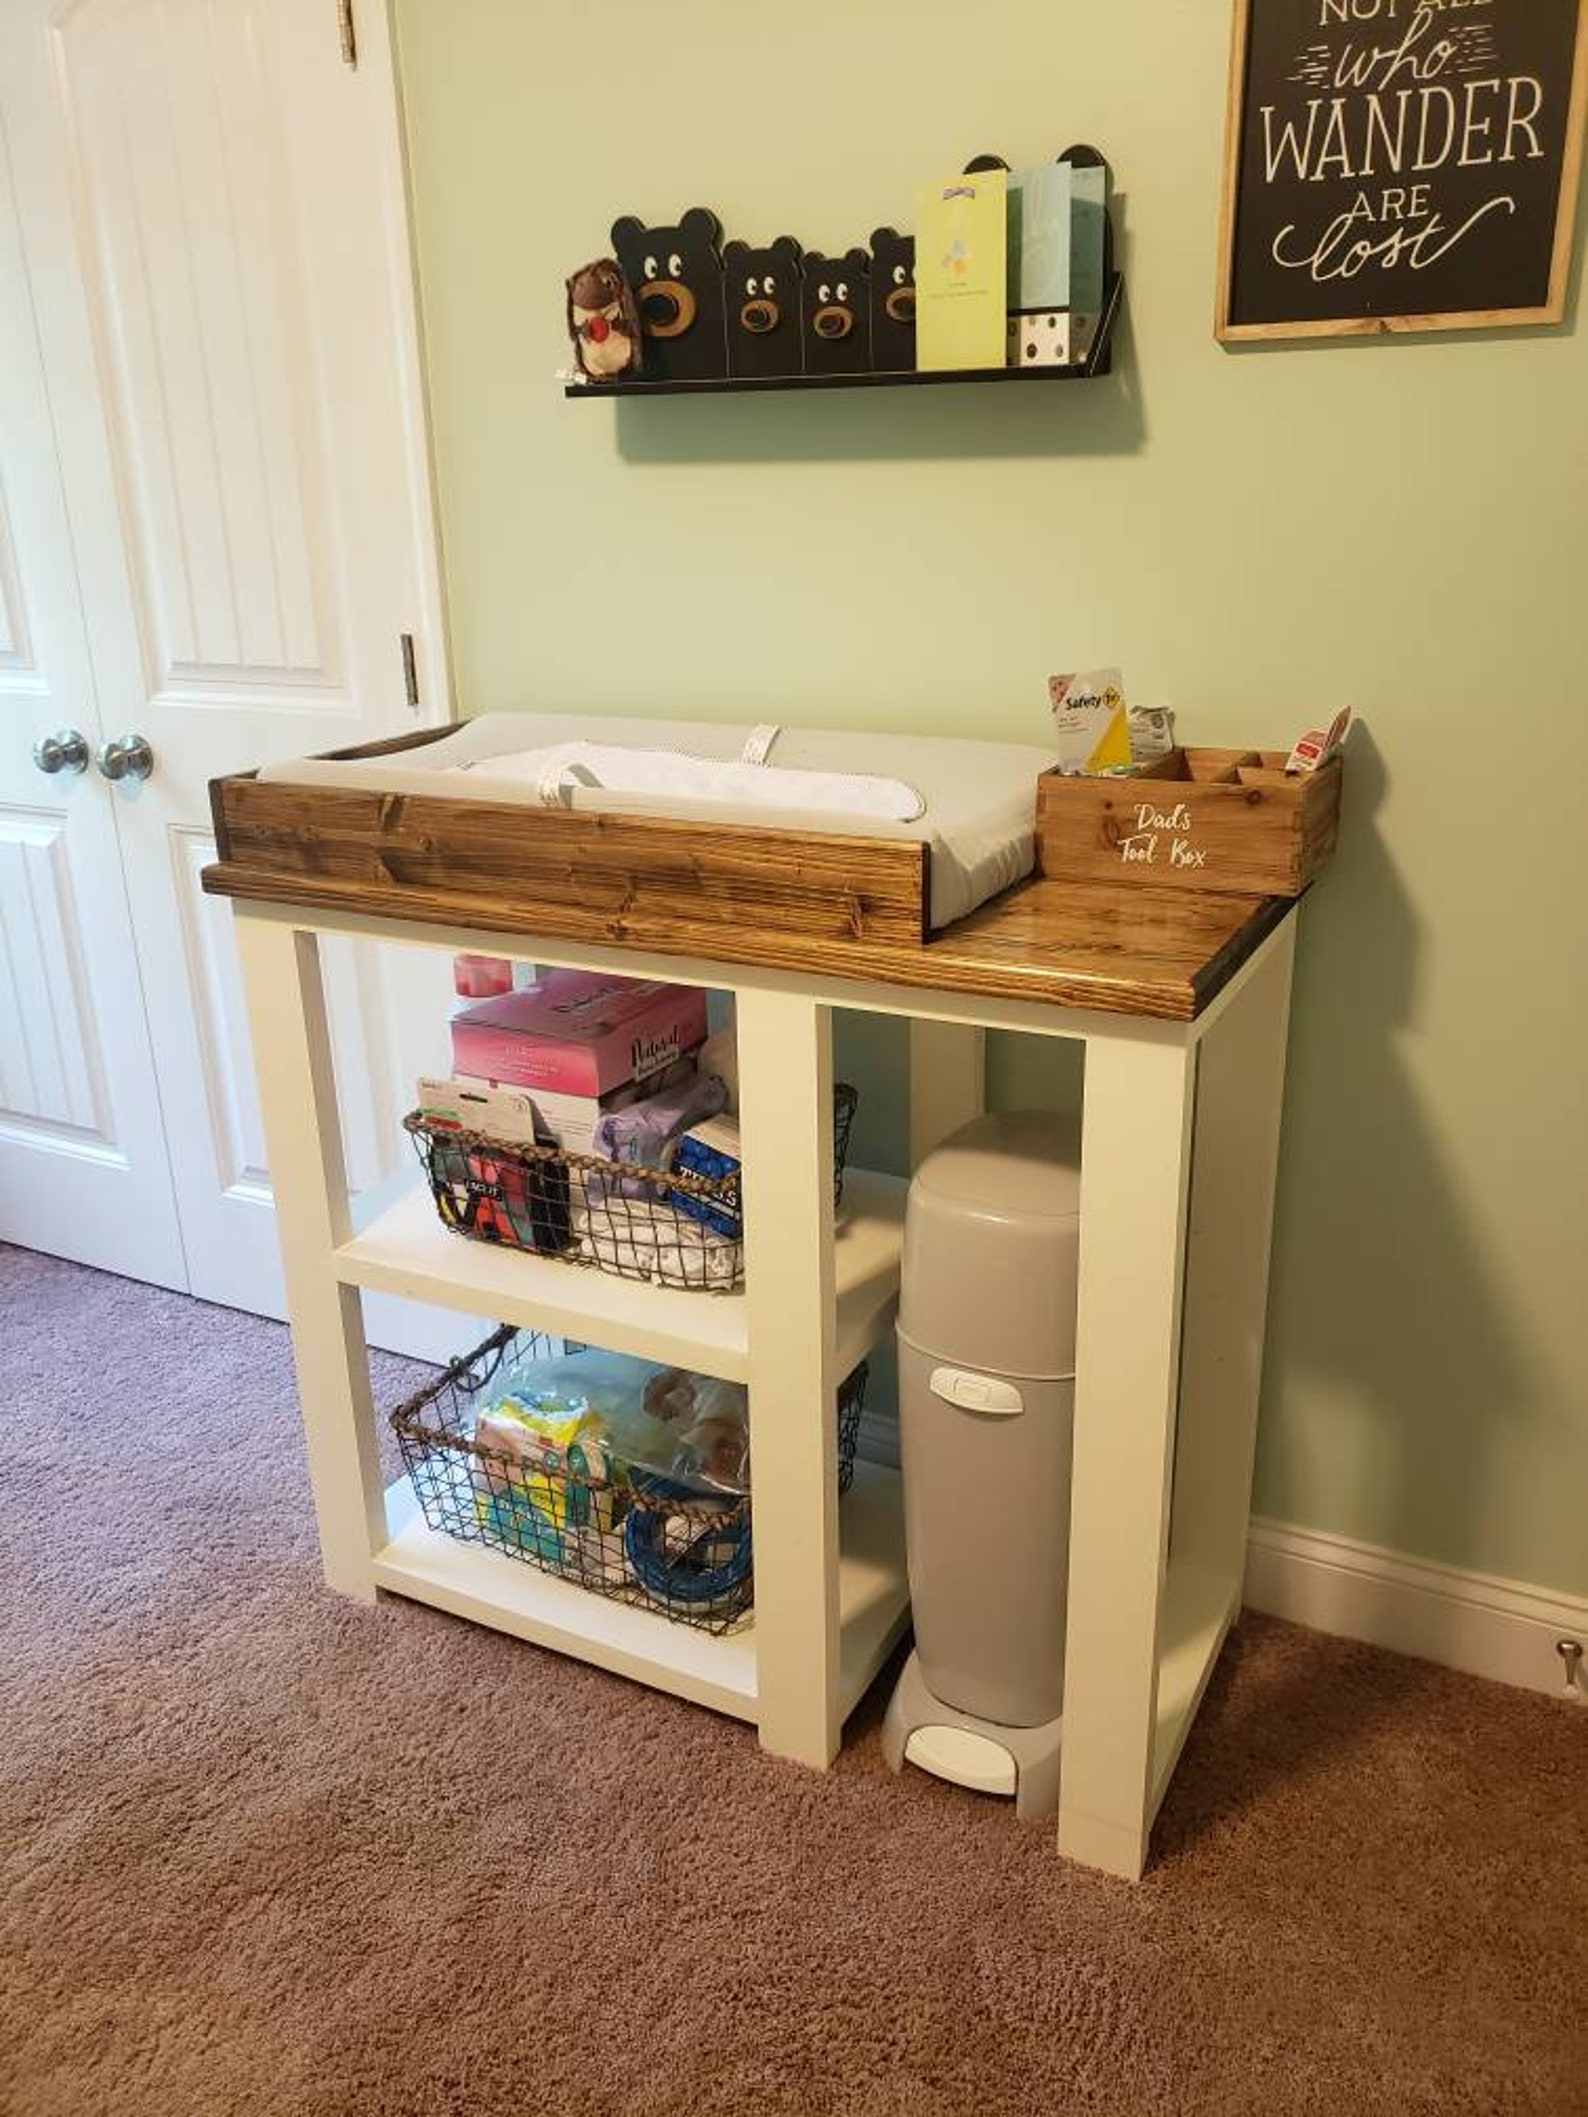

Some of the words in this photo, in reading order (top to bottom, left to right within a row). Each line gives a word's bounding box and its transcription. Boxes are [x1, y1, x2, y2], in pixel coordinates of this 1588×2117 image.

[1333, 7, 1459, 91] who
[1259, 76, 1545, 183] WANDER
[1272, 196, 1516, 282] lost
[1349, 184, 1432, 222] ARE
[1116, 832, 1159, 864] Tool
[1169, 838, 1207, 869] Box
